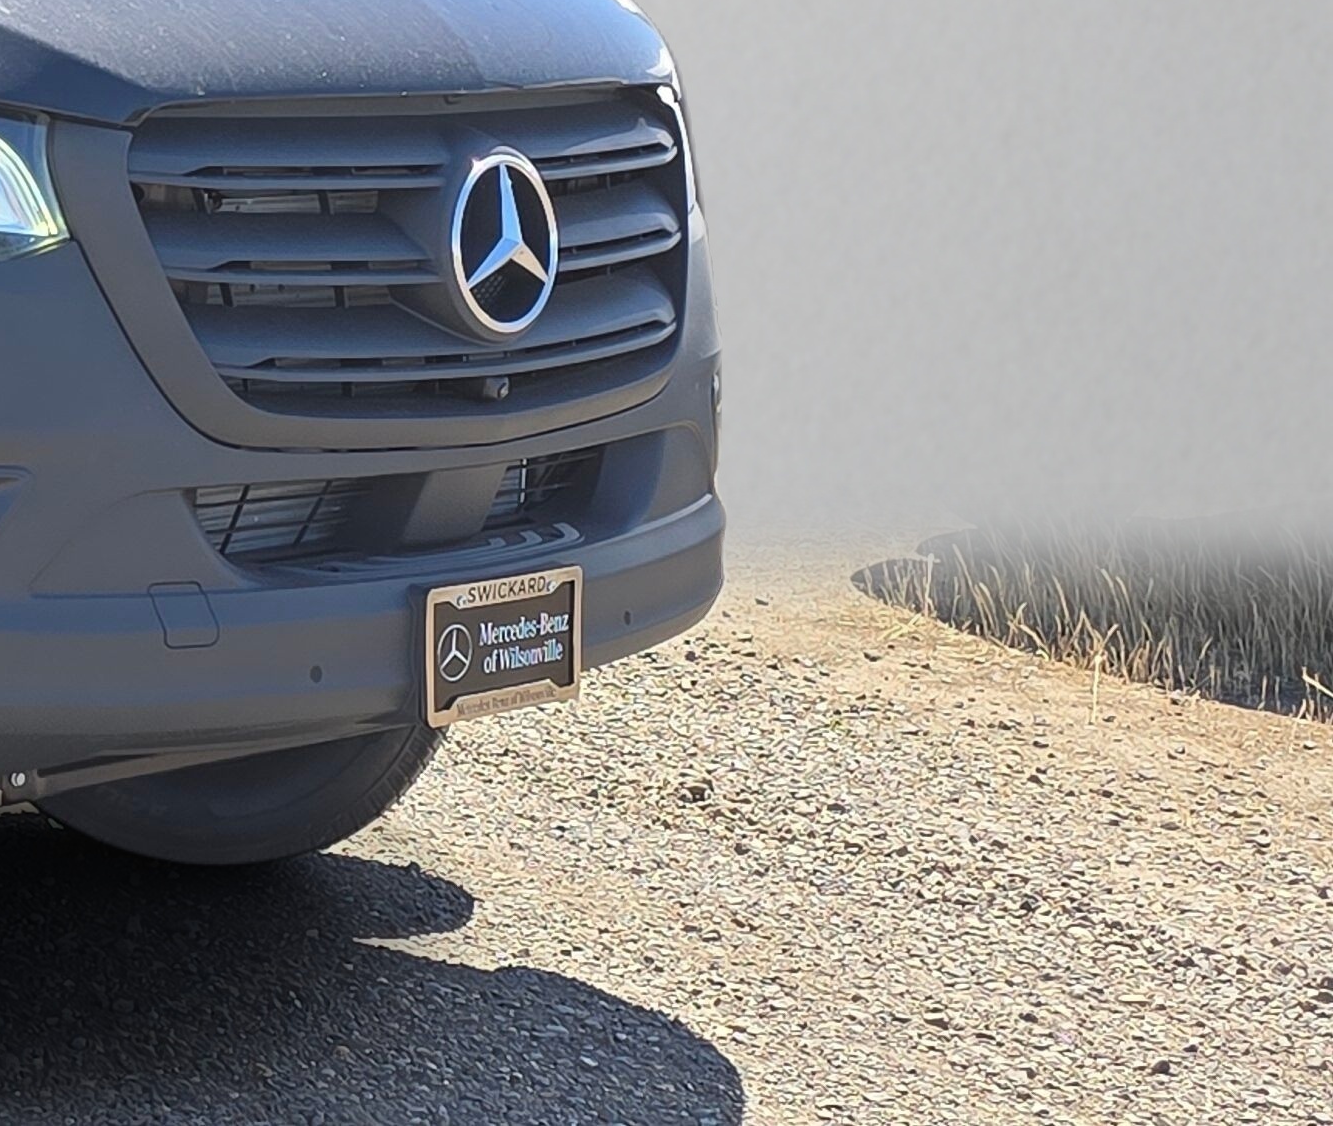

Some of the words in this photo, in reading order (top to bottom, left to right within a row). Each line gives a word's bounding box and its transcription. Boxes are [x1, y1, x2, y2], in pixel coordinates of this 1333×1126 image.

[467, 576, 546, 603] SWICKARD
[479, 612, 569, 646] Mercedes-Benz
[484, 649, 497, 673] of
[499, 638, 563, 670] Wilsonville
